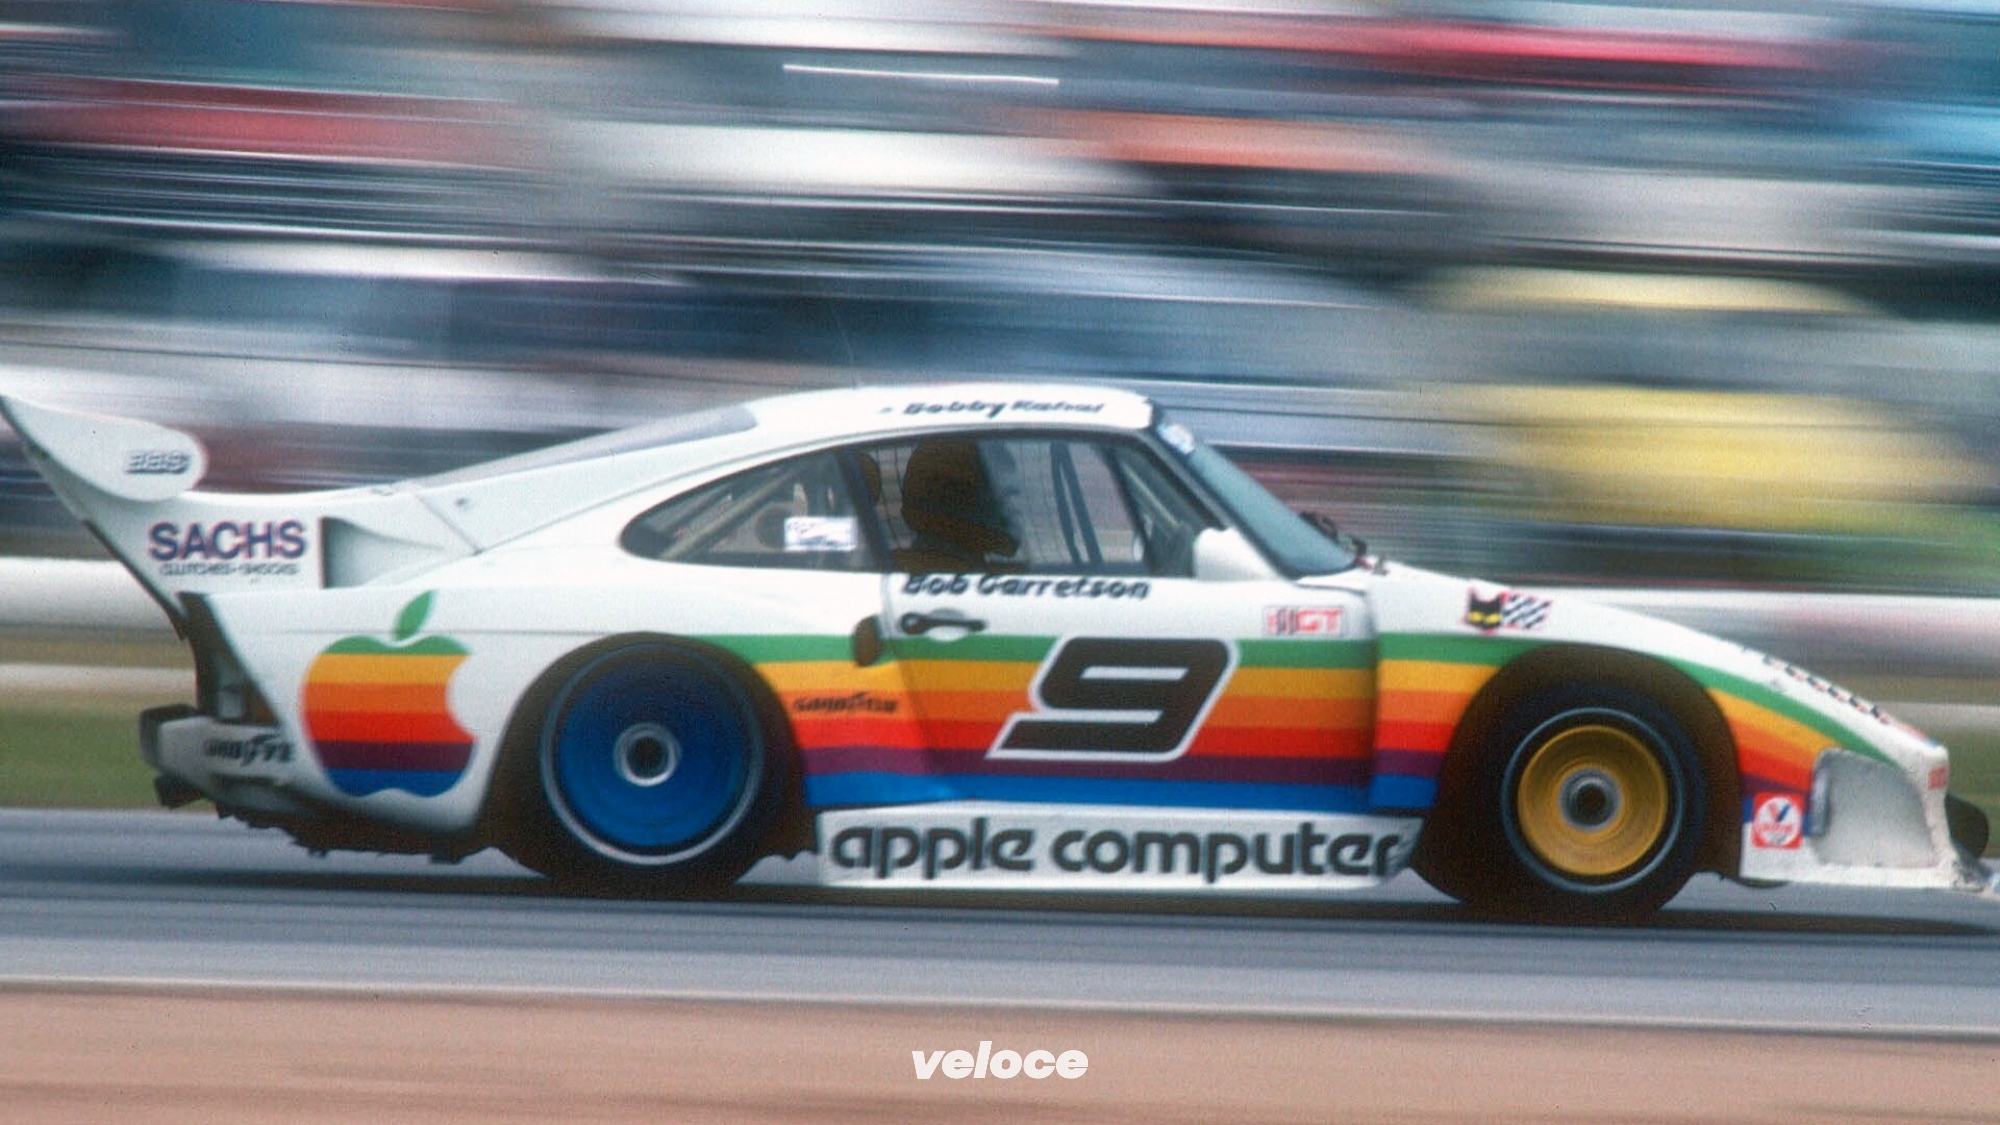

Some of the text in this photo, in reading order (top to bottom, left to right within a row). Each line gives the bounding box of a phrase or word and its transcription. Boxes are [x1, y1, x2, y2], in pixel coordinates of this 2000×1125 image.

[149, 519, 306, 561] SACHS
[902, 574, 1151, 598] Bob Garretson
[986, 636, 1238, 761] 9
[830, 817, 1404, 883] apple computer
